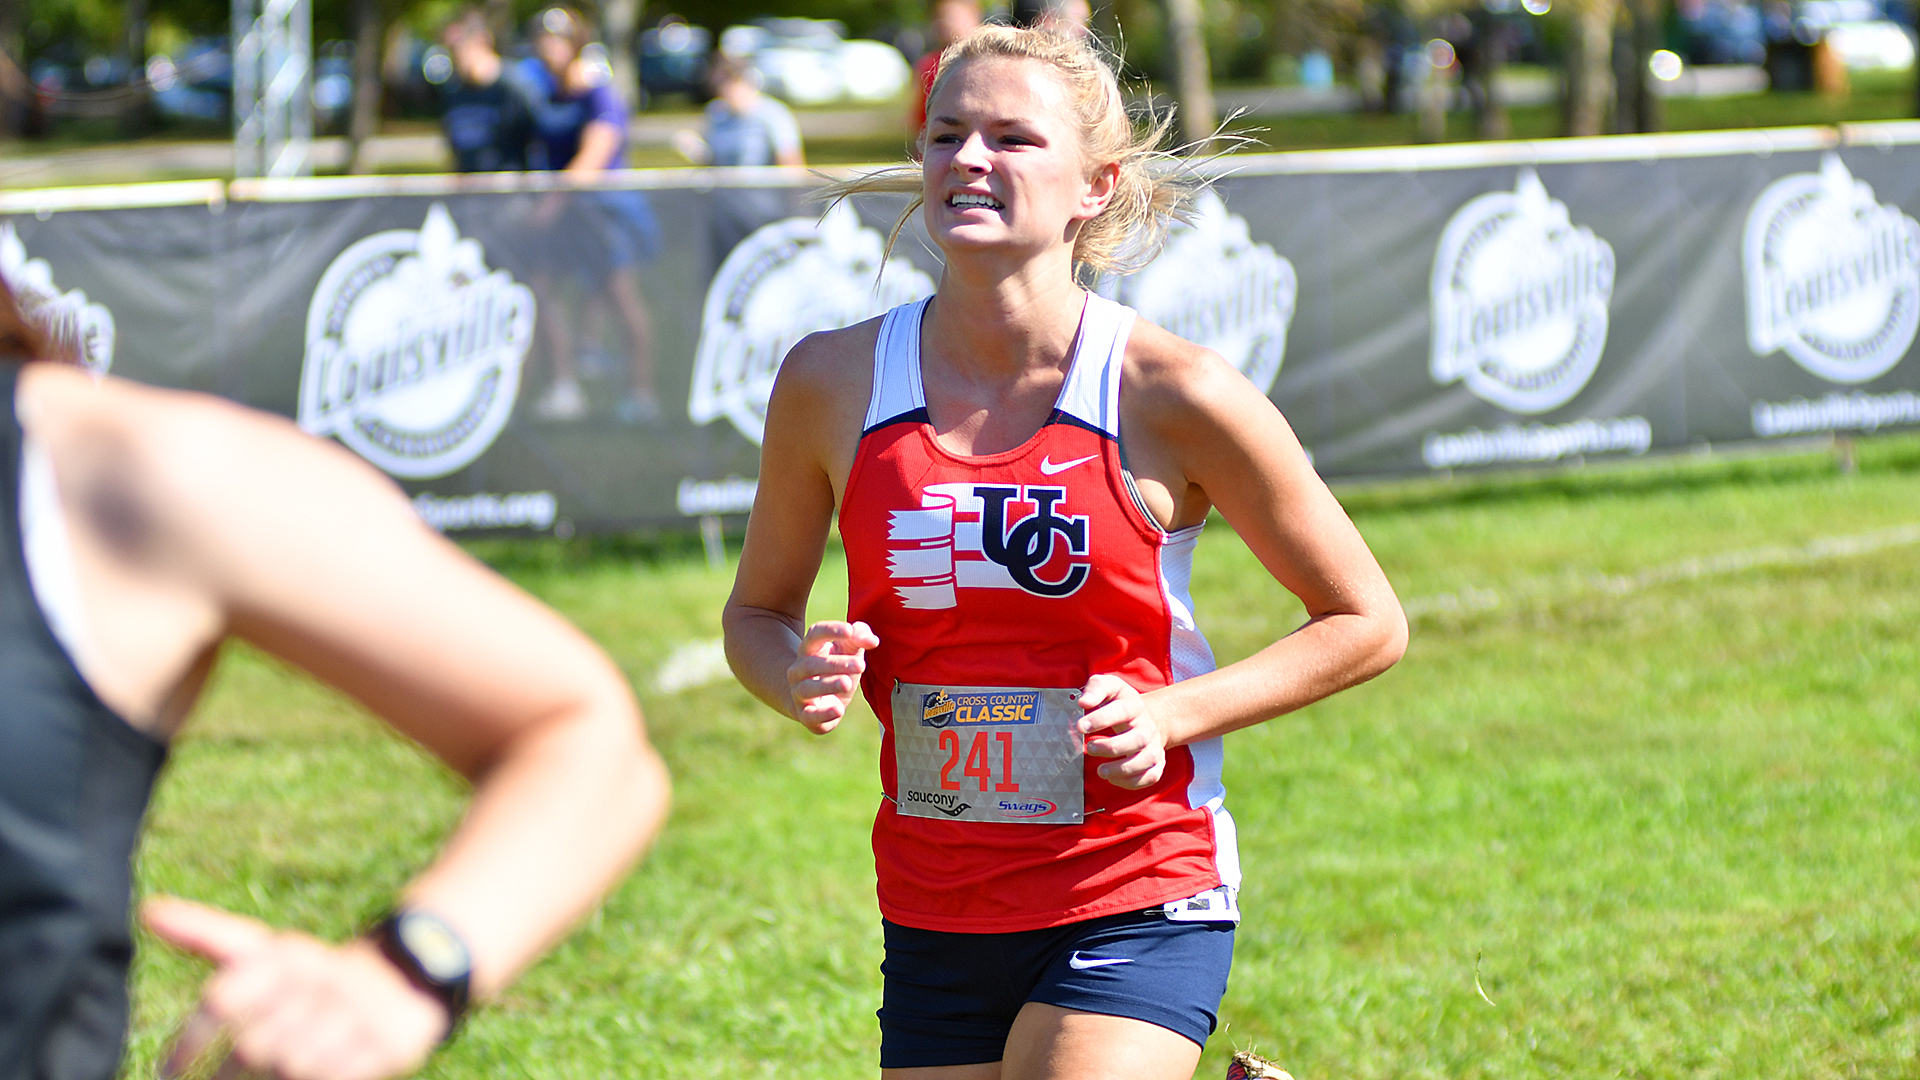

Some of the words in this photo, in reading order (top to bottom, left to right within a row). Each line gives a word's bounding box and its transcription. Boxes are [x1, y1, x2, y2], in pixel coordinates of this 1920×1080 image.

[1434, 232, 1615, 378] Louisville
[1748, 210, 1920, 352] Louisville
[300, 270, 535, 433] Louisville
[973, 485, 1091, 598] UC
[955, 704, 1033, 723] CLASSIC
[957, 696, 987, 706] CROSS
[990, 694, 1037, 705] COUNTRY
[939, 729, 1019, 793] 241
[907, 790, 956, 808] saucony
[998, 801, 1048, 813] Swags
